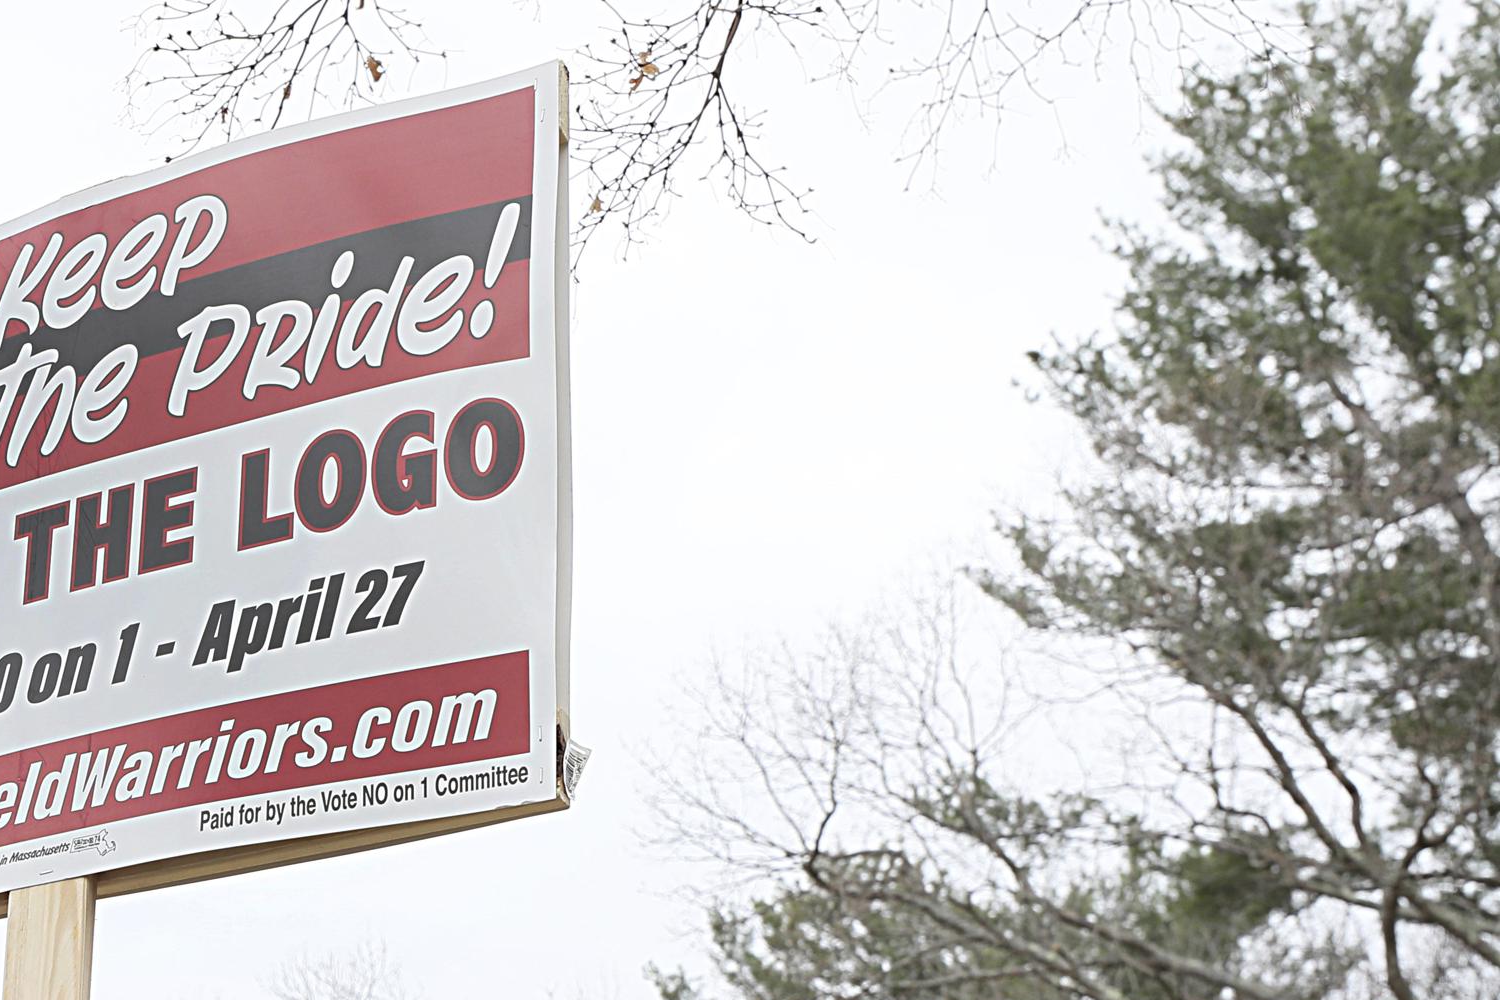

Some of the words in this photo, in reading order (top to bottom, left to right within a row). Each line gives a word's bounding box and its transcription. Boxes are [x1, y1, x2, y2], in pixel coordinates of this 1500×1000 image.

[14, 466, 199, 606] THE
[237, 397, 525, 552] LOGO
[27, 641, 97, 704] on
[111, 622, 140, 685] 1
[155, 641, 175, 658] -
[192, 572, 345, 675] April
[347, 560, 426, 635] 27
[200, 805, 234, 831] Paid
[239, 804, 261, 825] for
[266, 800, 285, 825] by
[291, 795, 316, 817] the
[321, 789, 357, 812] Vote
[362, 782, 388, 807] NO
[393, 782, 415, 802] on
[420, 777, 428, 798] 1
[435, 765, 528, 796] Committee
[0, 854, 8, 866] in
[9, 842, 71, 864] Massachusetts
